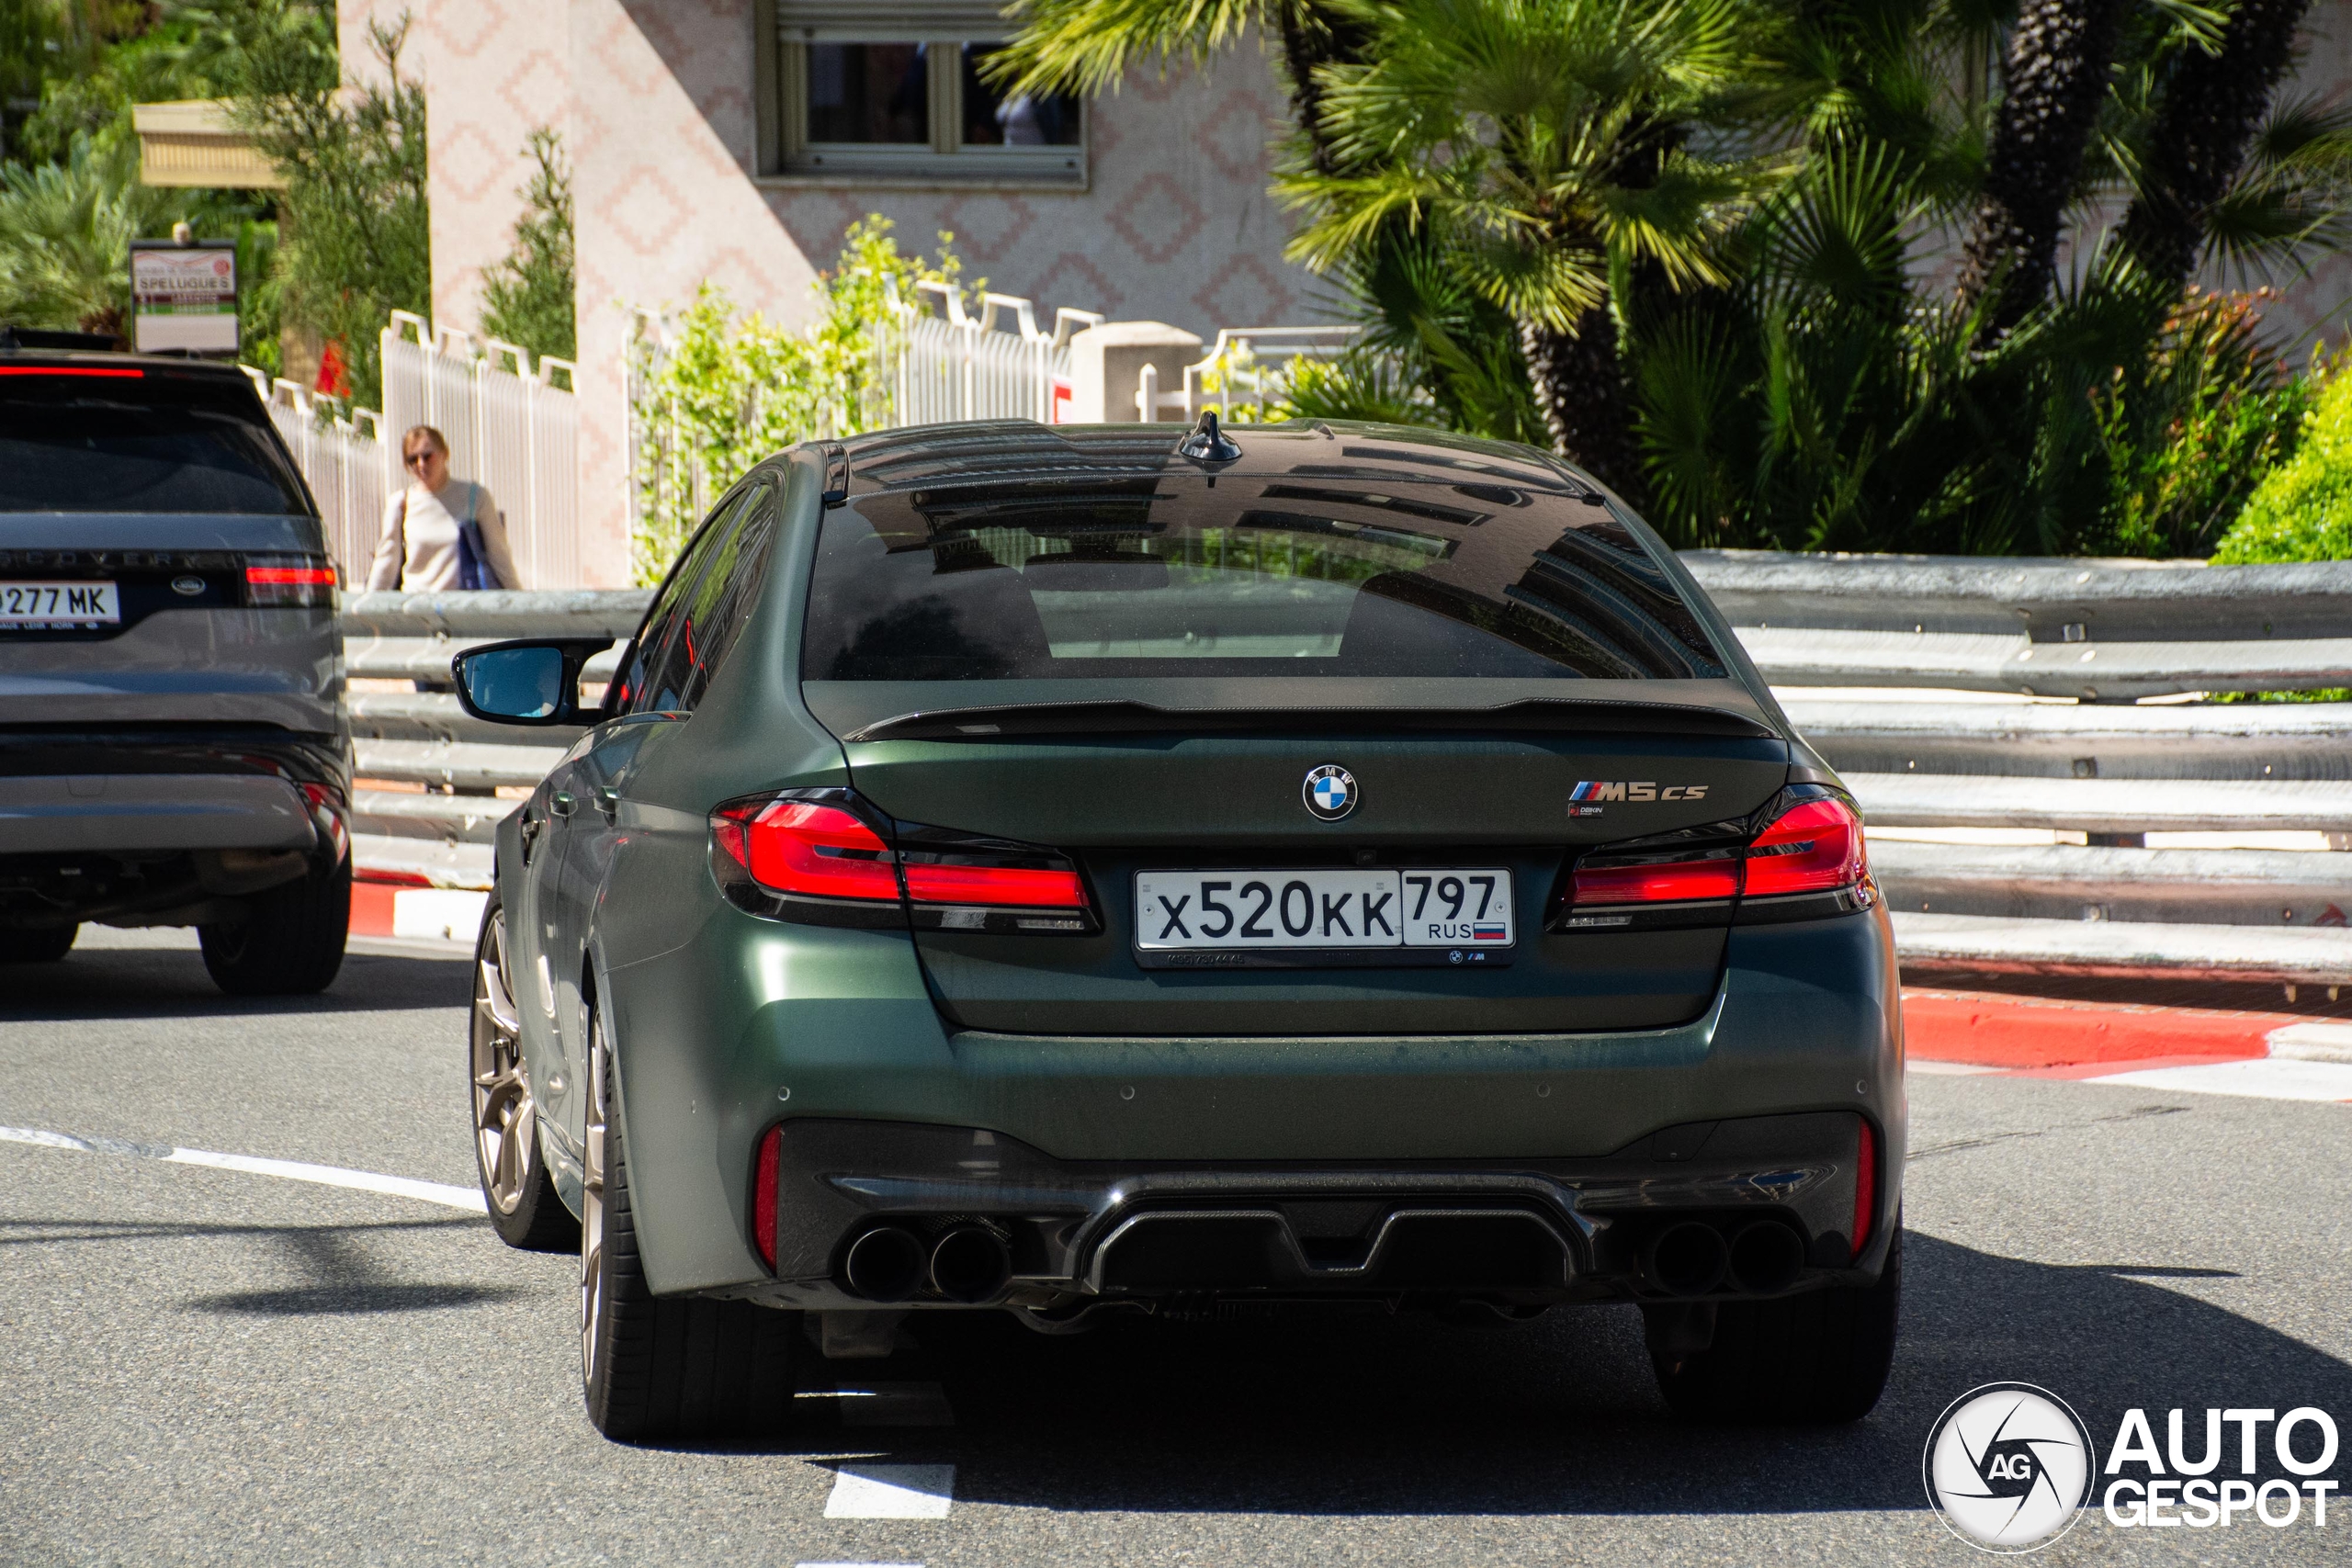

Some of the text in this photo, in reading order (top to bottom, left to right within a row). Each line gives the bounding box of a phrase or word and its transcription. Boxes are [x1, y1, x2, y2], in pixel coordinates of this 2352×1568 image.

[140, 277, 229, 288] SPELUGUES
[0, 587, 60, 614] 277
[1308, 767, 1352, 784] BMW
[1595, 782, 1710, 801] M5 CS
[1406, 876, 1496, 920] 797
[1429, 924, 1471, 939] RUS
